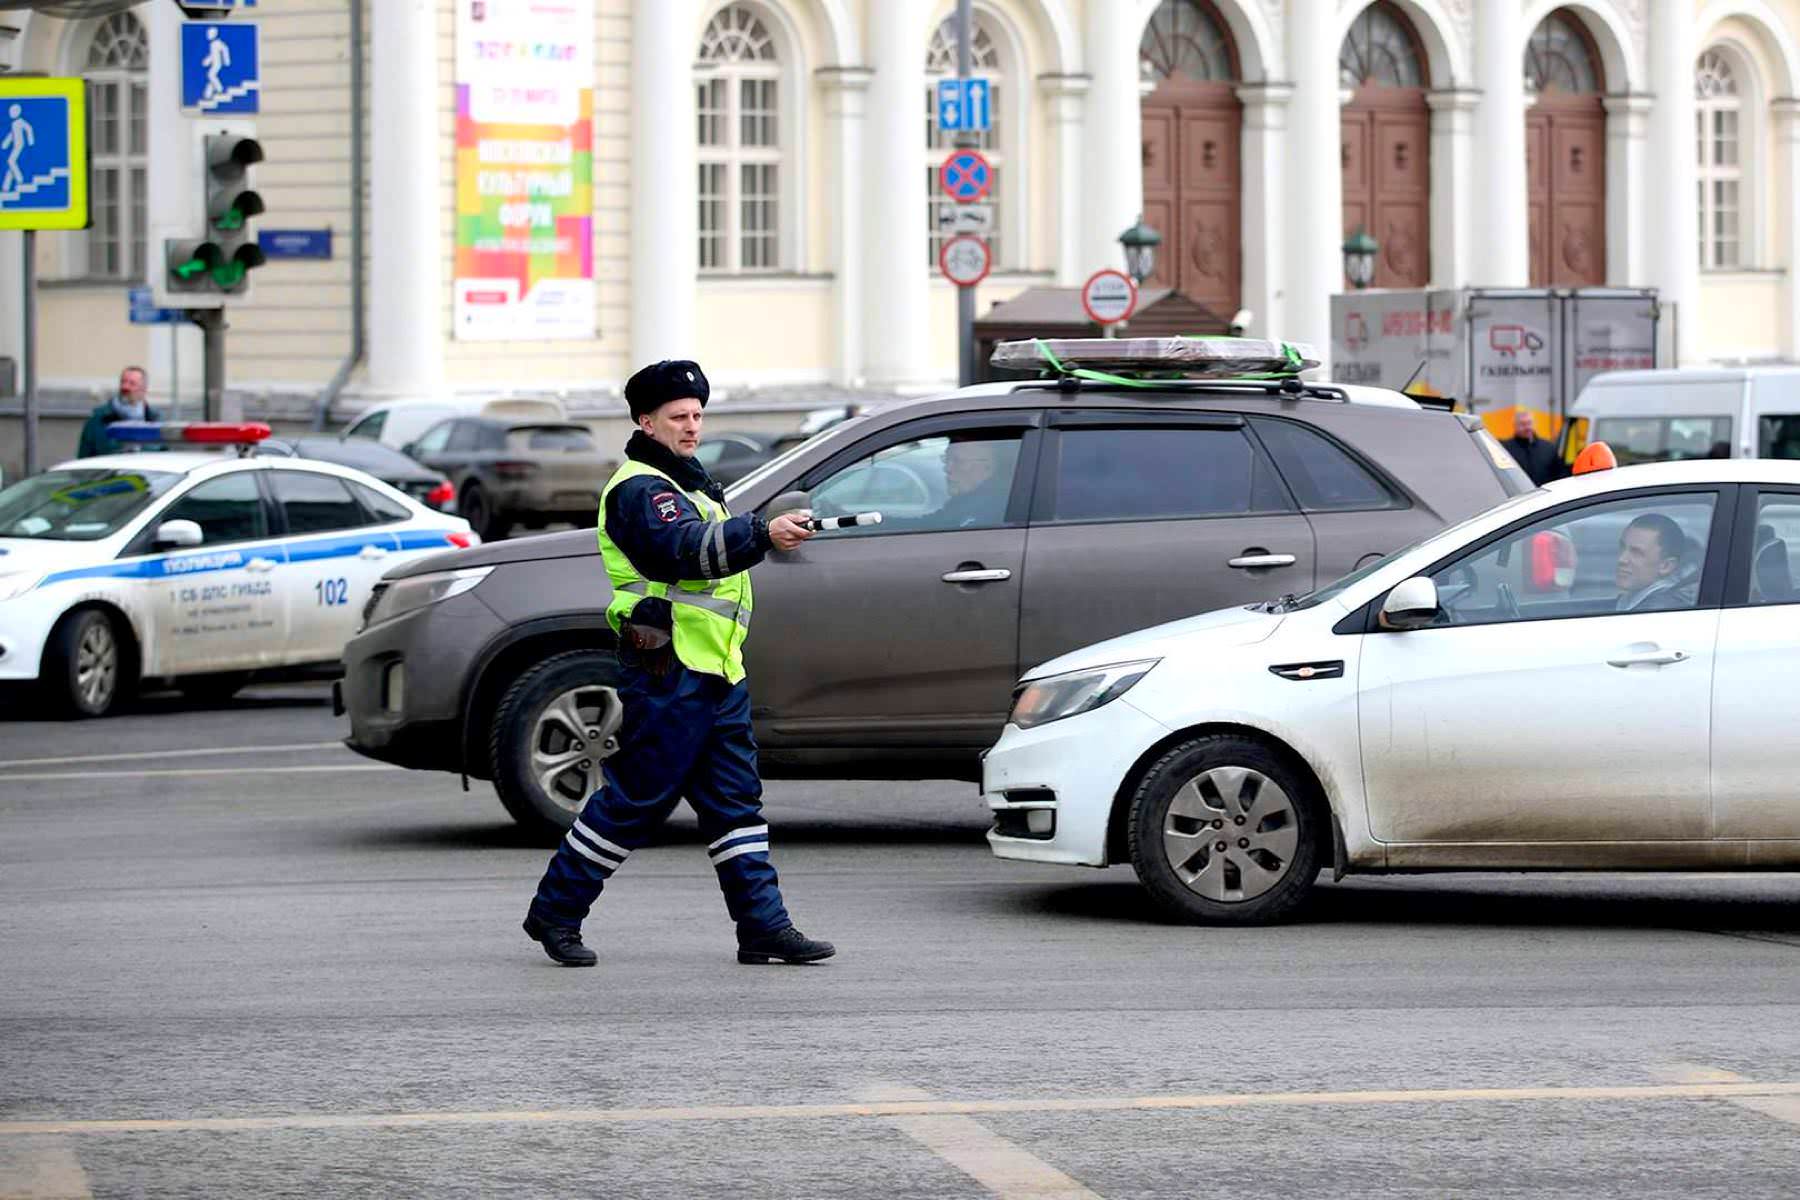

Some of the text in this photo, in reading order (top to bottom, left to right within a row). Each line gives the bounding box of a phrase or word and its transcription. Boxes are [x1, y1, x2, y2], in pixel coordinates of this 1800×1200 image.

[162, 552, 243, 573] ПОЛИЦИЯ
[202, 584, 228, 600] ДПС
[231, 581, 272, 597] ГИБДД
[315, 578, 349, 606] 102
